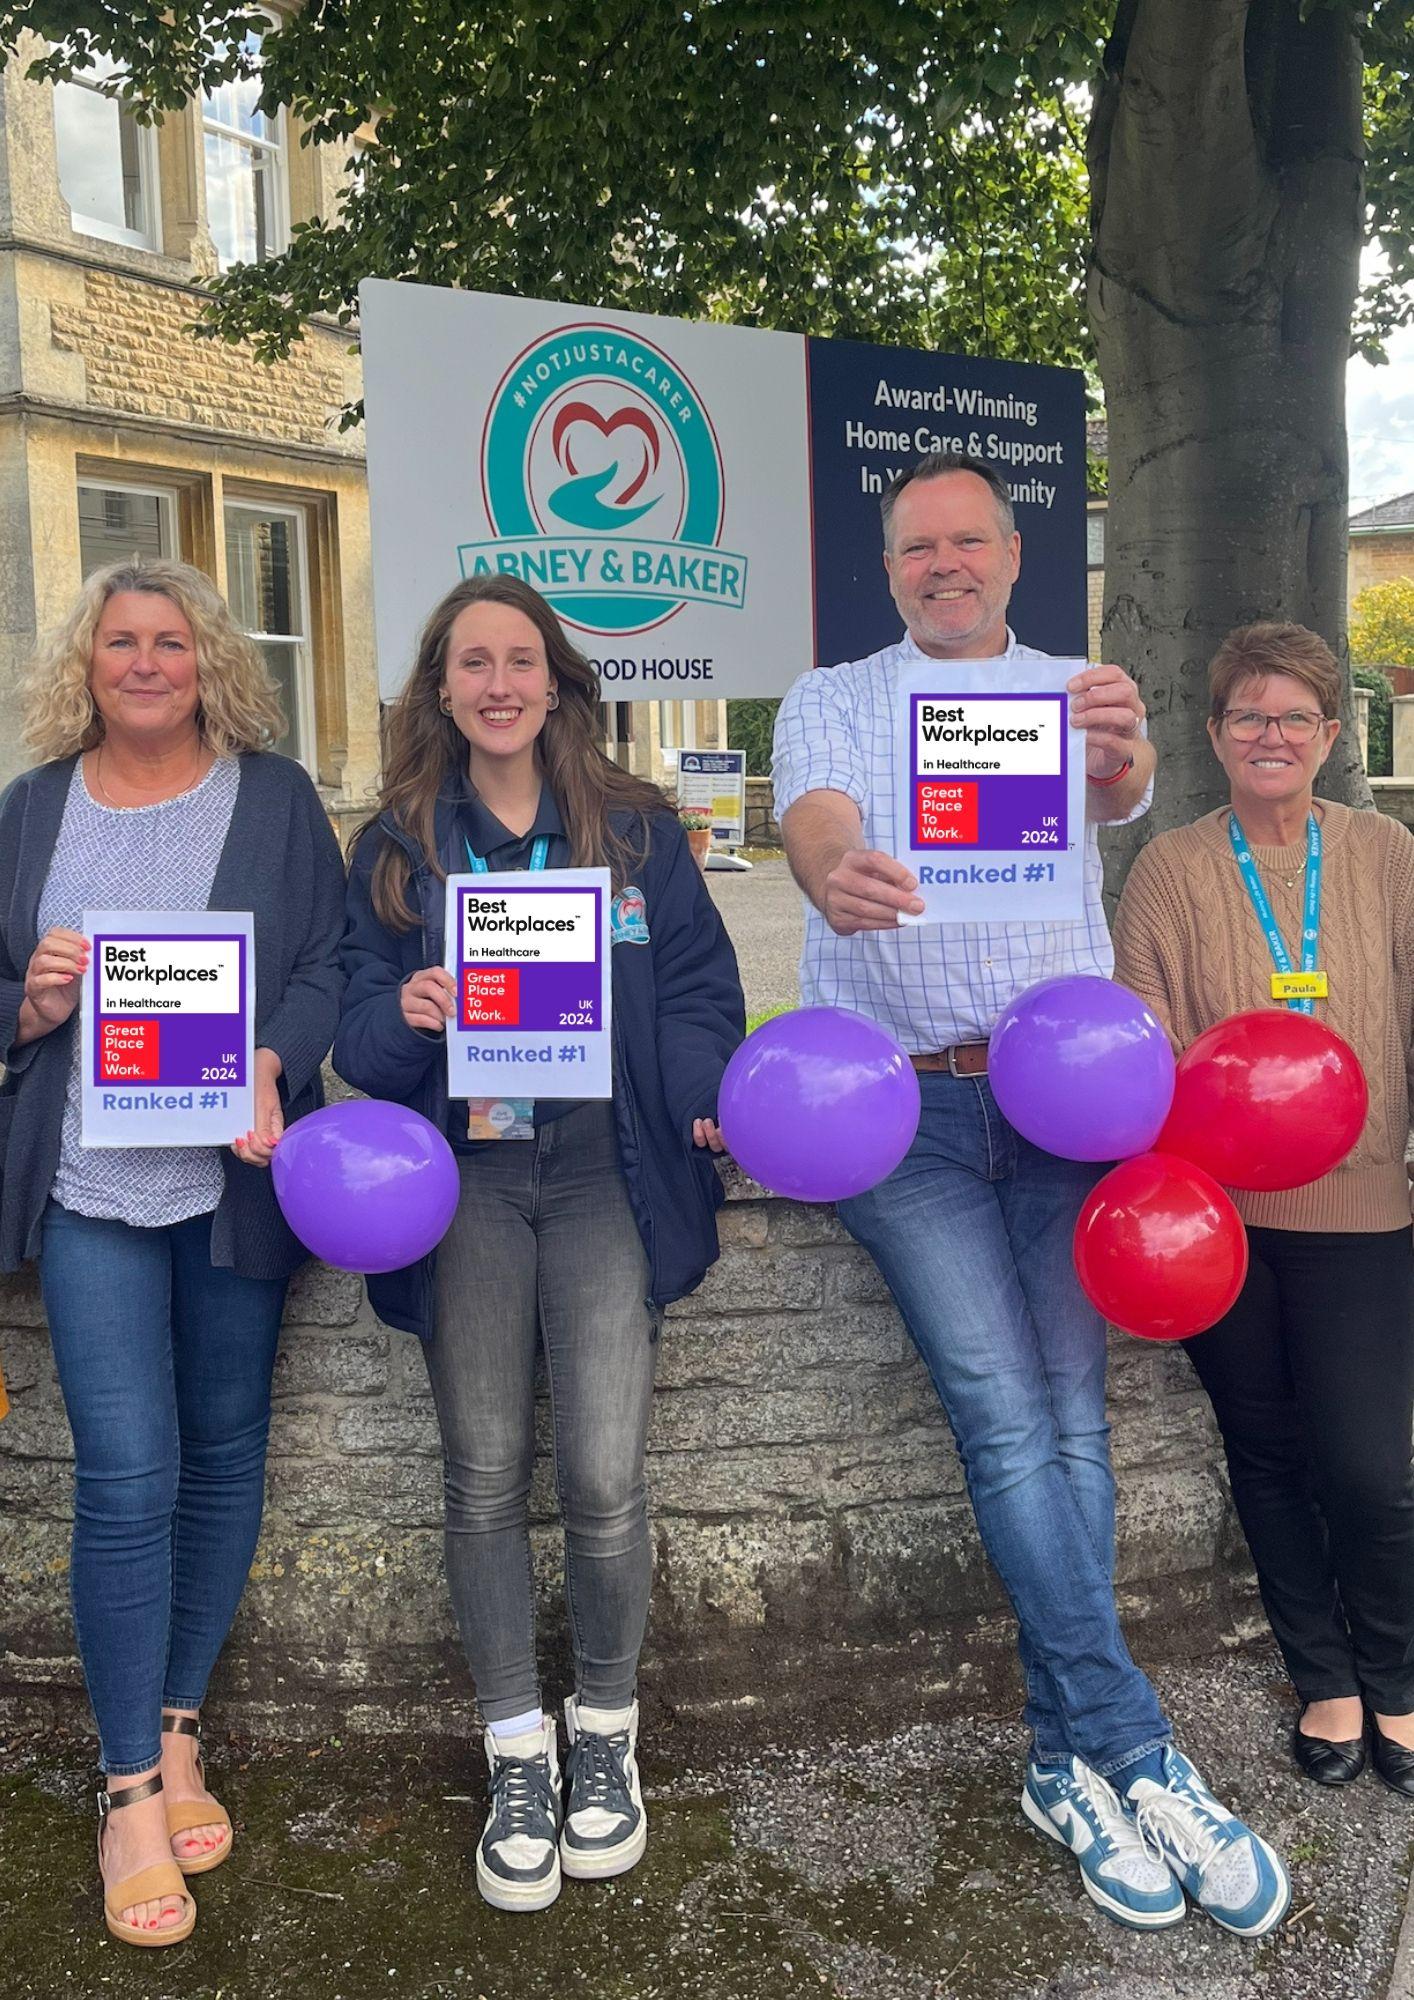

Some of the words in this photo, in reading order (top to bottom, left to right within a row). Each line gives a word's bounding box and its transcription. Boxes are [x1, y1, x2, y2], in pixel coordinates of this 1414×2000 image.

[512, 344, 691, 423] #NOTJUSTACARER
[874, 379, 1038, 426] Award-Winning
[846, 420, 910, 453] Home
[914, 427, 963, 454] Care
[967, 431, 983, 458] &
[986, 433, 1063, 466] Support
[861, 466, 882, 493] In
[1007, 477, 1057, 509] unity
[600, 549, 625, 583] &
[633, 551, 740, 598] BAKER
[642, 658, 713, 680] HOUSE
[923, 706, 964, 722] Best
[923, 759, 933, 769] in
[937, 760, 1000, 769] Healthcare
[921, 786, 963, 798] Great
[923, 800, 962, 811] Place
[922, 814, 937, 824] To
[1043, 817, 1057, 826] UK
[1022, 831, 1058, 843] 2024
[919, 864, 1016, 884] Ranked
[1023, 863, 1054, 882] #1
[469, 899, 506, 913] Best
[1268, 929, 1285, 957] BAKER
[106, 947, 145, 962] Best
[469, 948, 479, 957] in
[482, 948, 540, 956] Healthcare
[467, 973, 505, 983] Great
[468, 984, 504, 995] Place
[1283, 984, 1317, 994] Paula
[106, 998, 116, 1008] in
[120, 999, 181, 1008] Healthcare
[468, 998, 481, 1007] To
[579, 1000, 592, 1009] UK
[560, 1013, 593, 1024] 2024
[105, 1025, 144, 1035] Great
[105, 1037, 144, 1048] Place
[105, 1051, 120, 1061] To
[222, 1054, 237, 1063] UK
[468, 1046, 551, 1062] Ranked
[558, 1045, 586, 1062] #1
[202, 1068, 237, 1079] 2024
[103, 1092, 192, 1109] Ranked
[200, 1091, 228, 1109] #1
